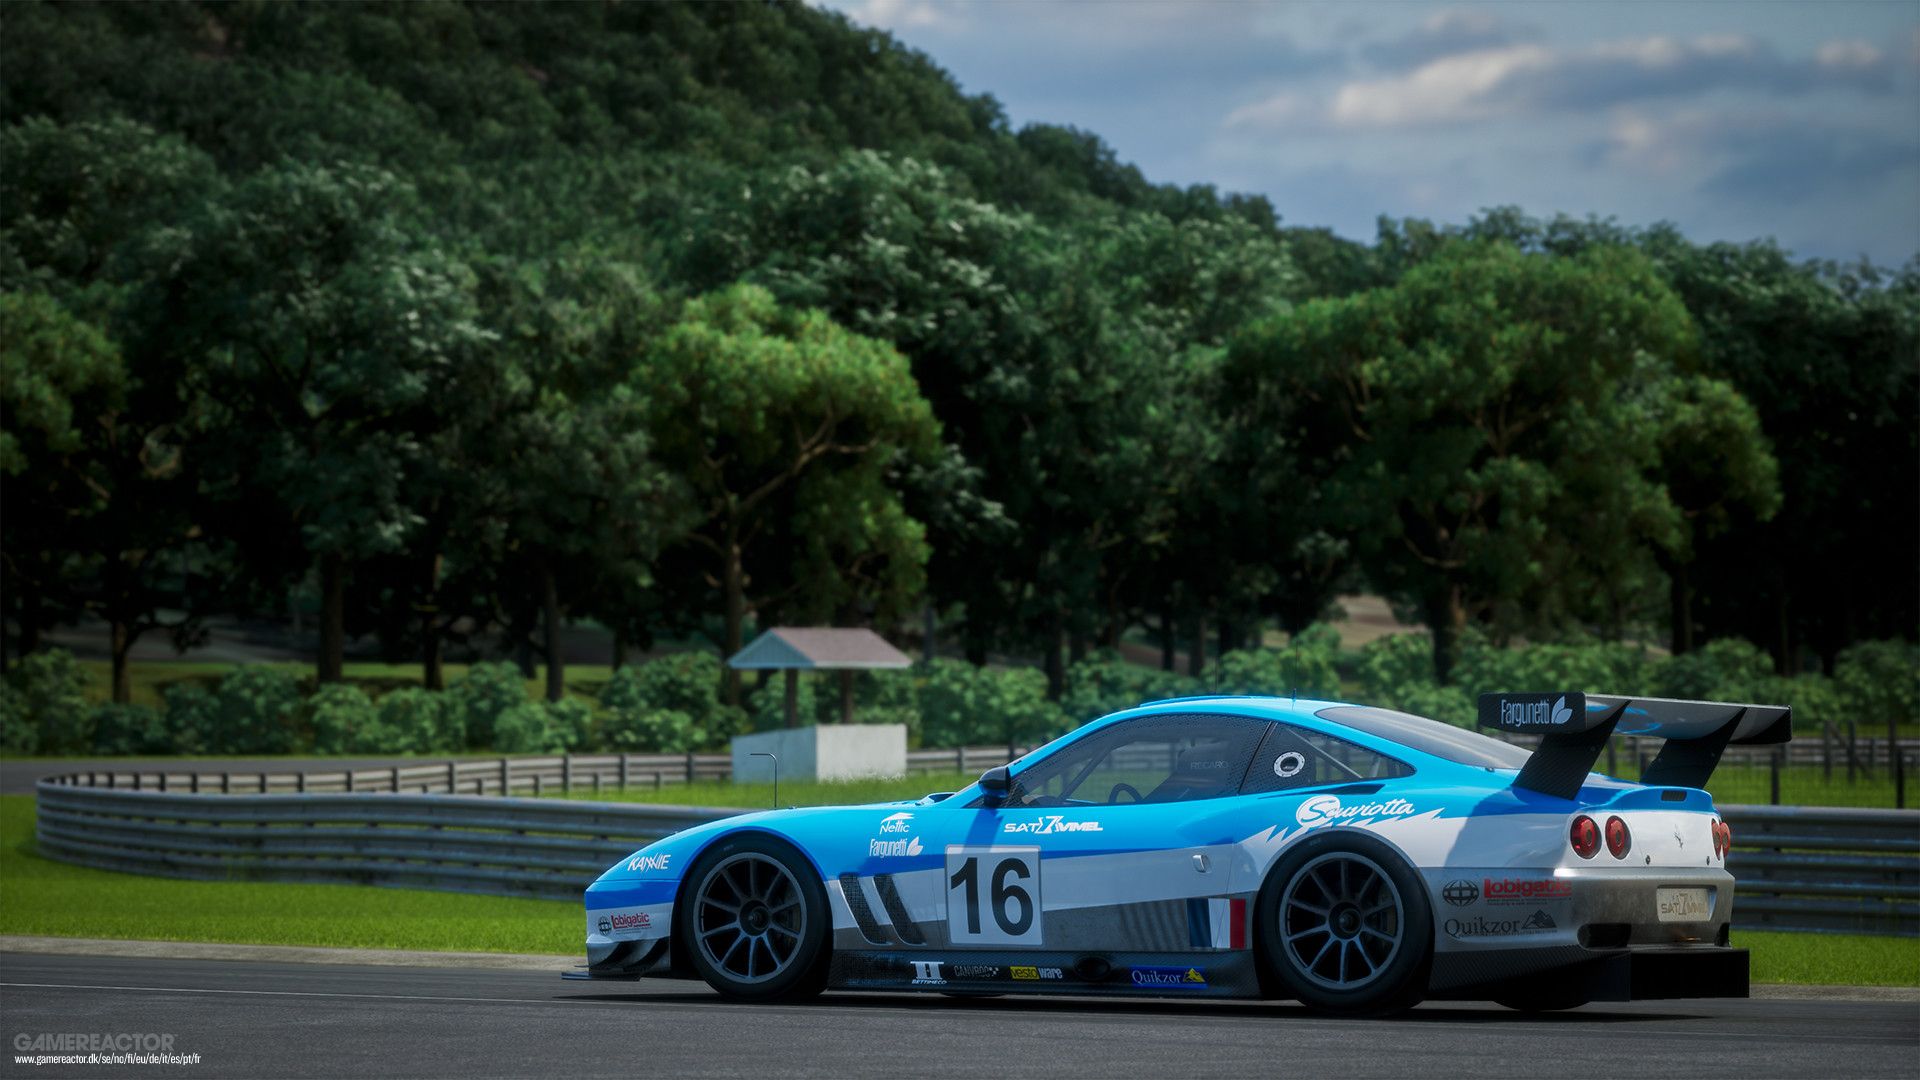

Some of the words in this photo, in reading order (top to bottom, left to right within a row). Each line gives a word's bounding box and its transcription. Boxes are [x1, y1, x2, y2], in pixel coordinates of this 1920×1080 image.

[1501, 699, 1549, 727] Fargunetti
[869, 838, 908, 858] Fargunetti
[950, 857, 1034, 936] 16
[1483, 878, 1573, 898] Lobigatic
[1444, 916, 1520, 939] Quikzor
[1131, 969, 1181, 984] Quikzor
